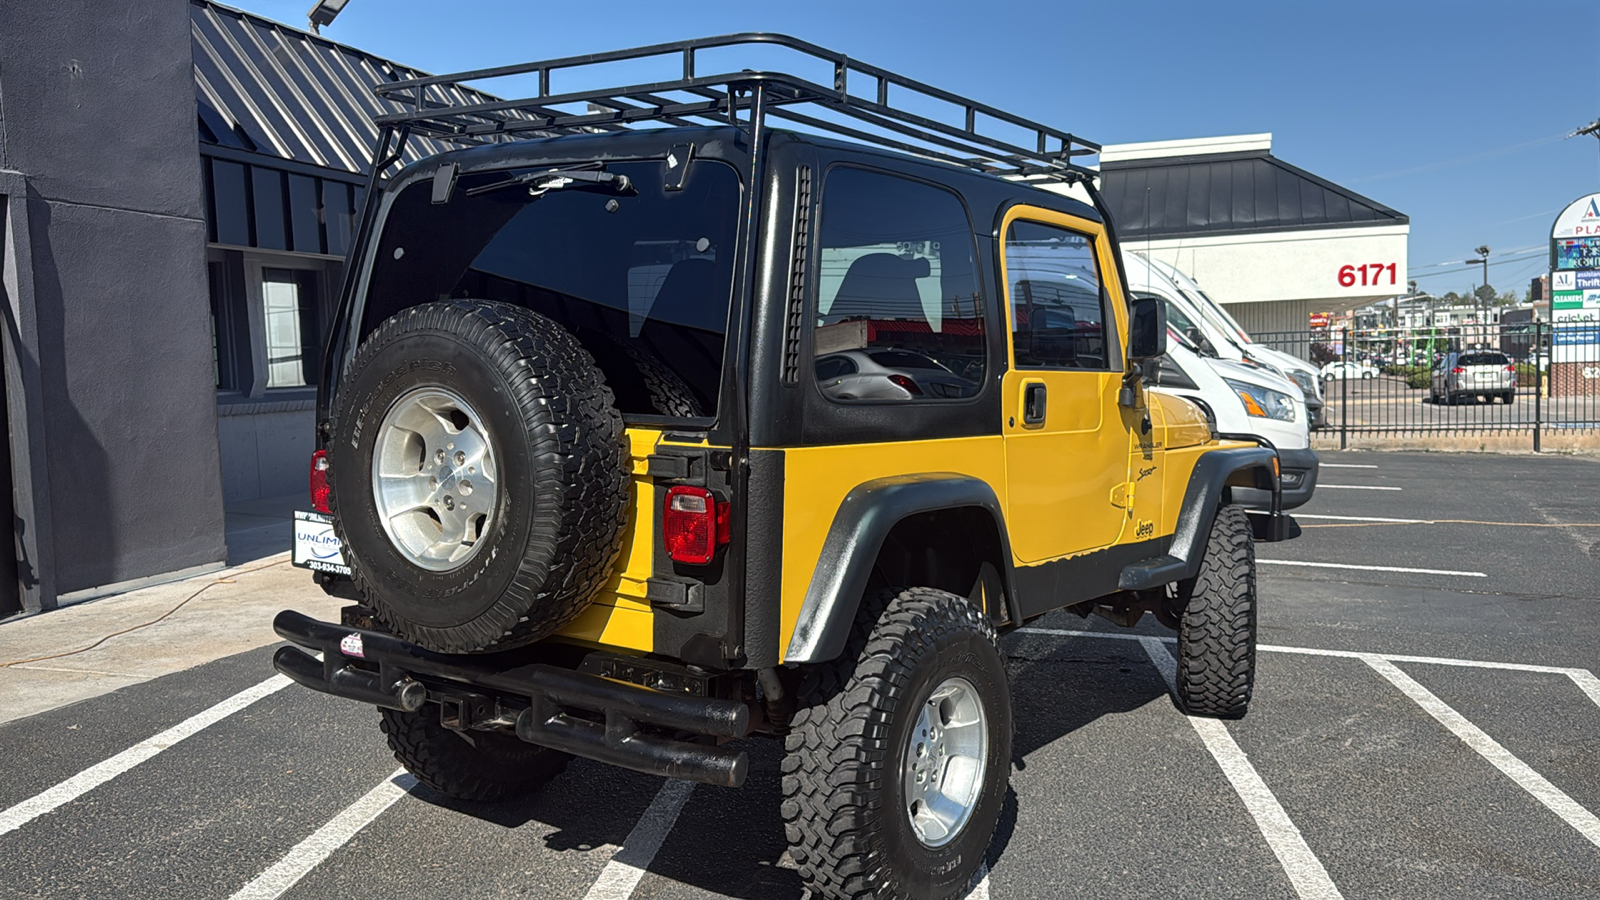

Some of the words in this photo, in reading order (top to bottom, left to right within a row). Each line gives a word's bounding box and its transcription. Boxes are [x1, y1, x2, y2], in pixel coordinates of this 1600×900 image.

[1575, 225, 1600, 235] PLA
[1337, 262, 1396, 288] 6171
[1553, 295, 1583, 303] CLEANERS
[1557, 313, 1596, 322] cricket
[1133, 441, 1163, 450] WRANGLER
[1135, 520, 1154, 537] Jeep
[297, 532, 341, 546] UNLIMI
